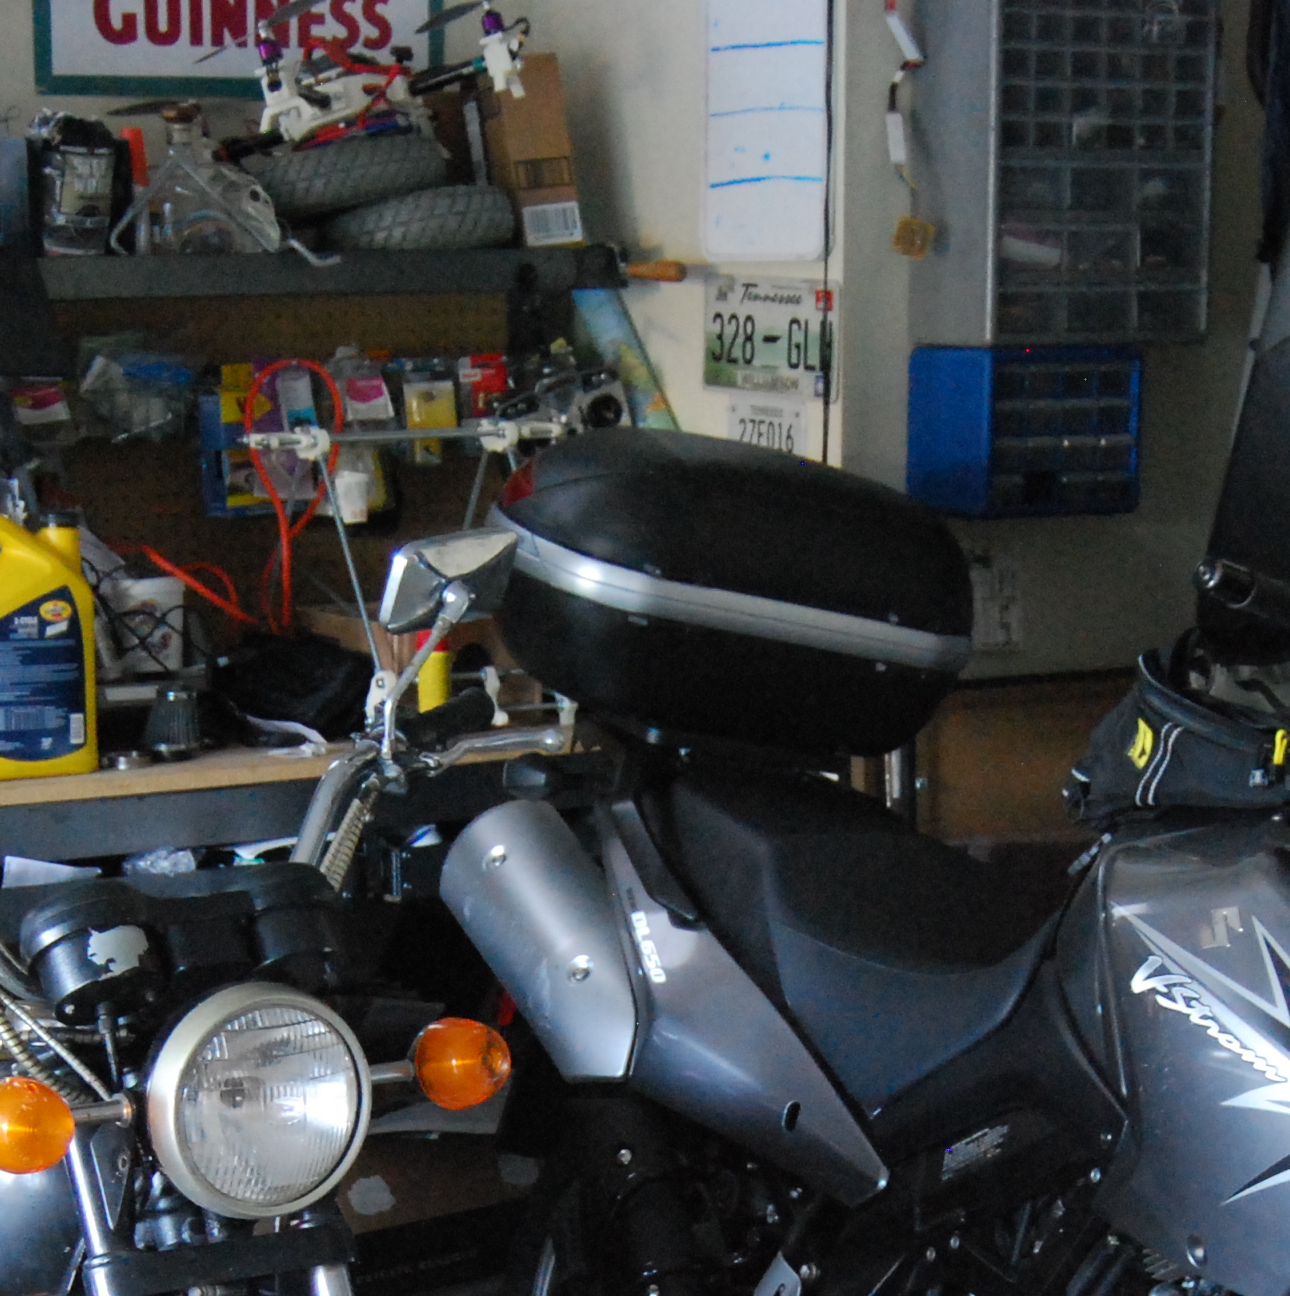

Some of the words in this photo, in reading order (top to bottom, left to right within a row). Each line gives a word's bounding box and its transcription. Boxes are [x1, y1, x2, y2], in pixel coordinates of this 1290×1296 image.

[92, 0, 392, 50] GUINNESS
[740, 282, 802, 305] Tennessee
[711, 311, 756, 365] 328
[631, 911, 667, 984] DL650
